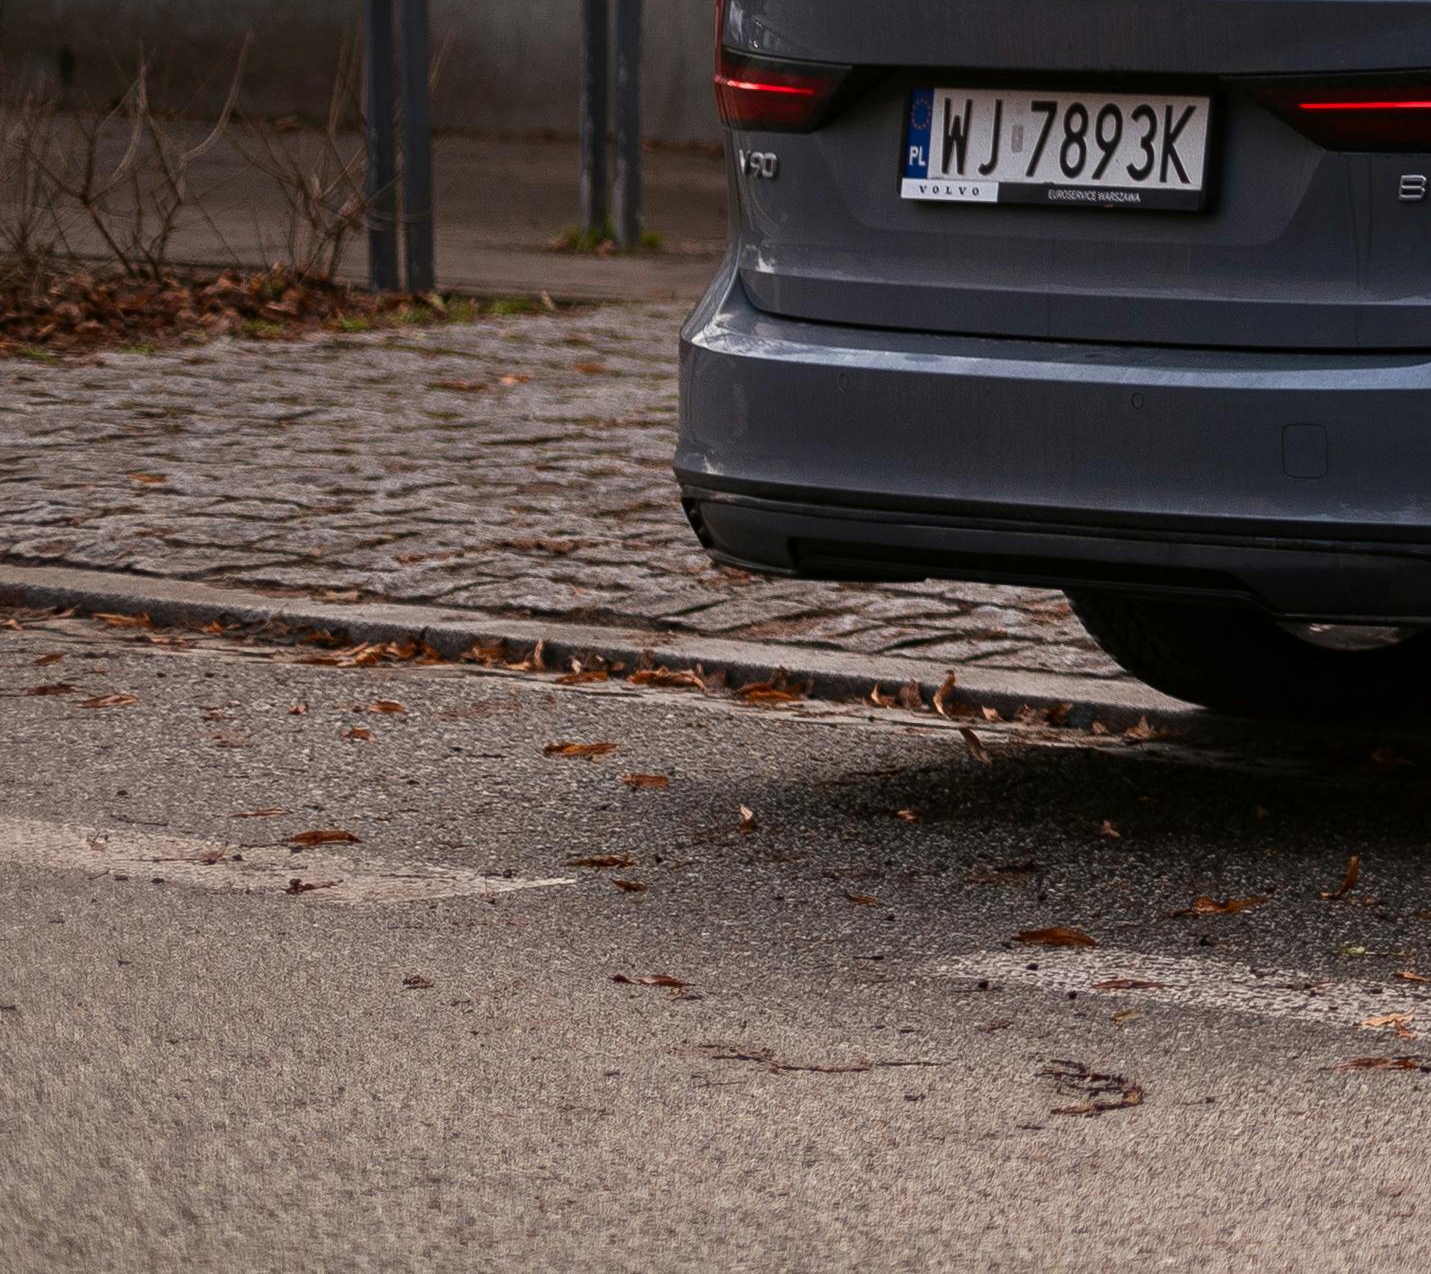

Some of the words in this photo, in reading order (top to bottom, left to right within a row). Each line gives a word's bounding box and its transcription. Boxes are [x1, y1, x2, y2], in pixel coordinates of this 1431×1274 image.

[940, 97, 1004, 177] WJ
[1025, 100, 1198, 185] 7893K
[737, 147, 778, 179] V90
[908, 144, 927, 167] PL
[918, 184, 981, 196] VOLVO
[1047, 188, 1097, 202] EUROSERVICE
[1098, 190, 1142, 204] WARSZAWA
